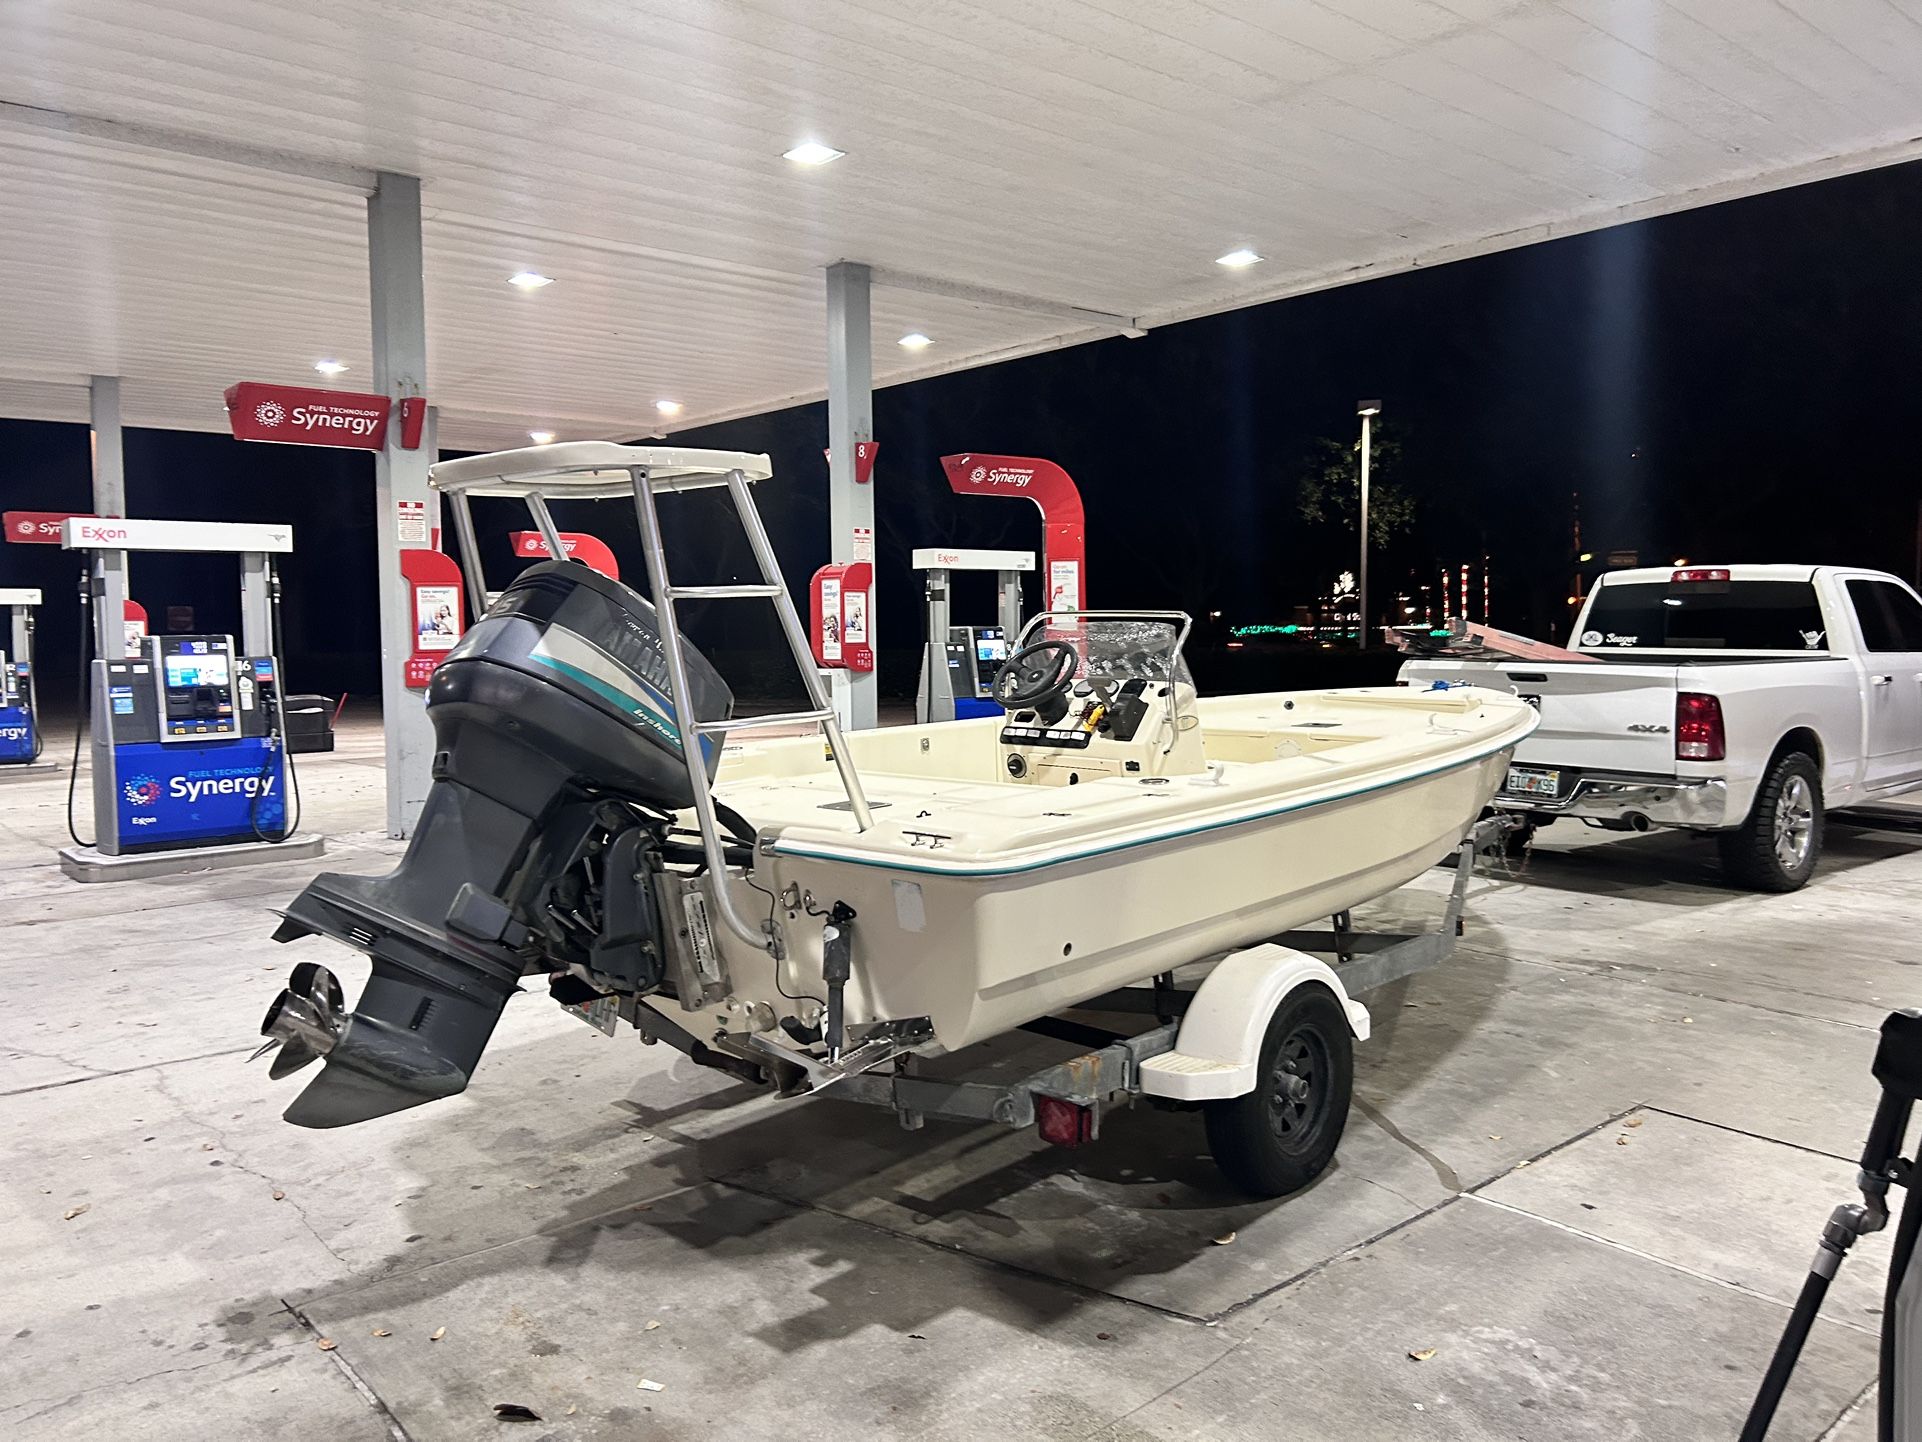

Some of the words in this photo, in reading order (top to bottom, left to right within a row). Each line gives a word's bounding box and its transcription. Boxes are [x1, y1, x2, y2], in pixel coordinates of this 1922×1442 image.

[308, 404, 328, 413] FUEL
[329, 406, 380, 417] TECHNOLOGY
[291, 408, 379, 435] Synergy
[858, 444, 865, 458] 8
[987, 469, 1032, 487] Synergy
[81, 526, 127, 542] Exxon
[938, 553, 959, 564] Exxon
[188, 770, 213, 778] FUEL
[169, 775, 275, 803] Synergy
[131, 817, 157, 826] Exxon
